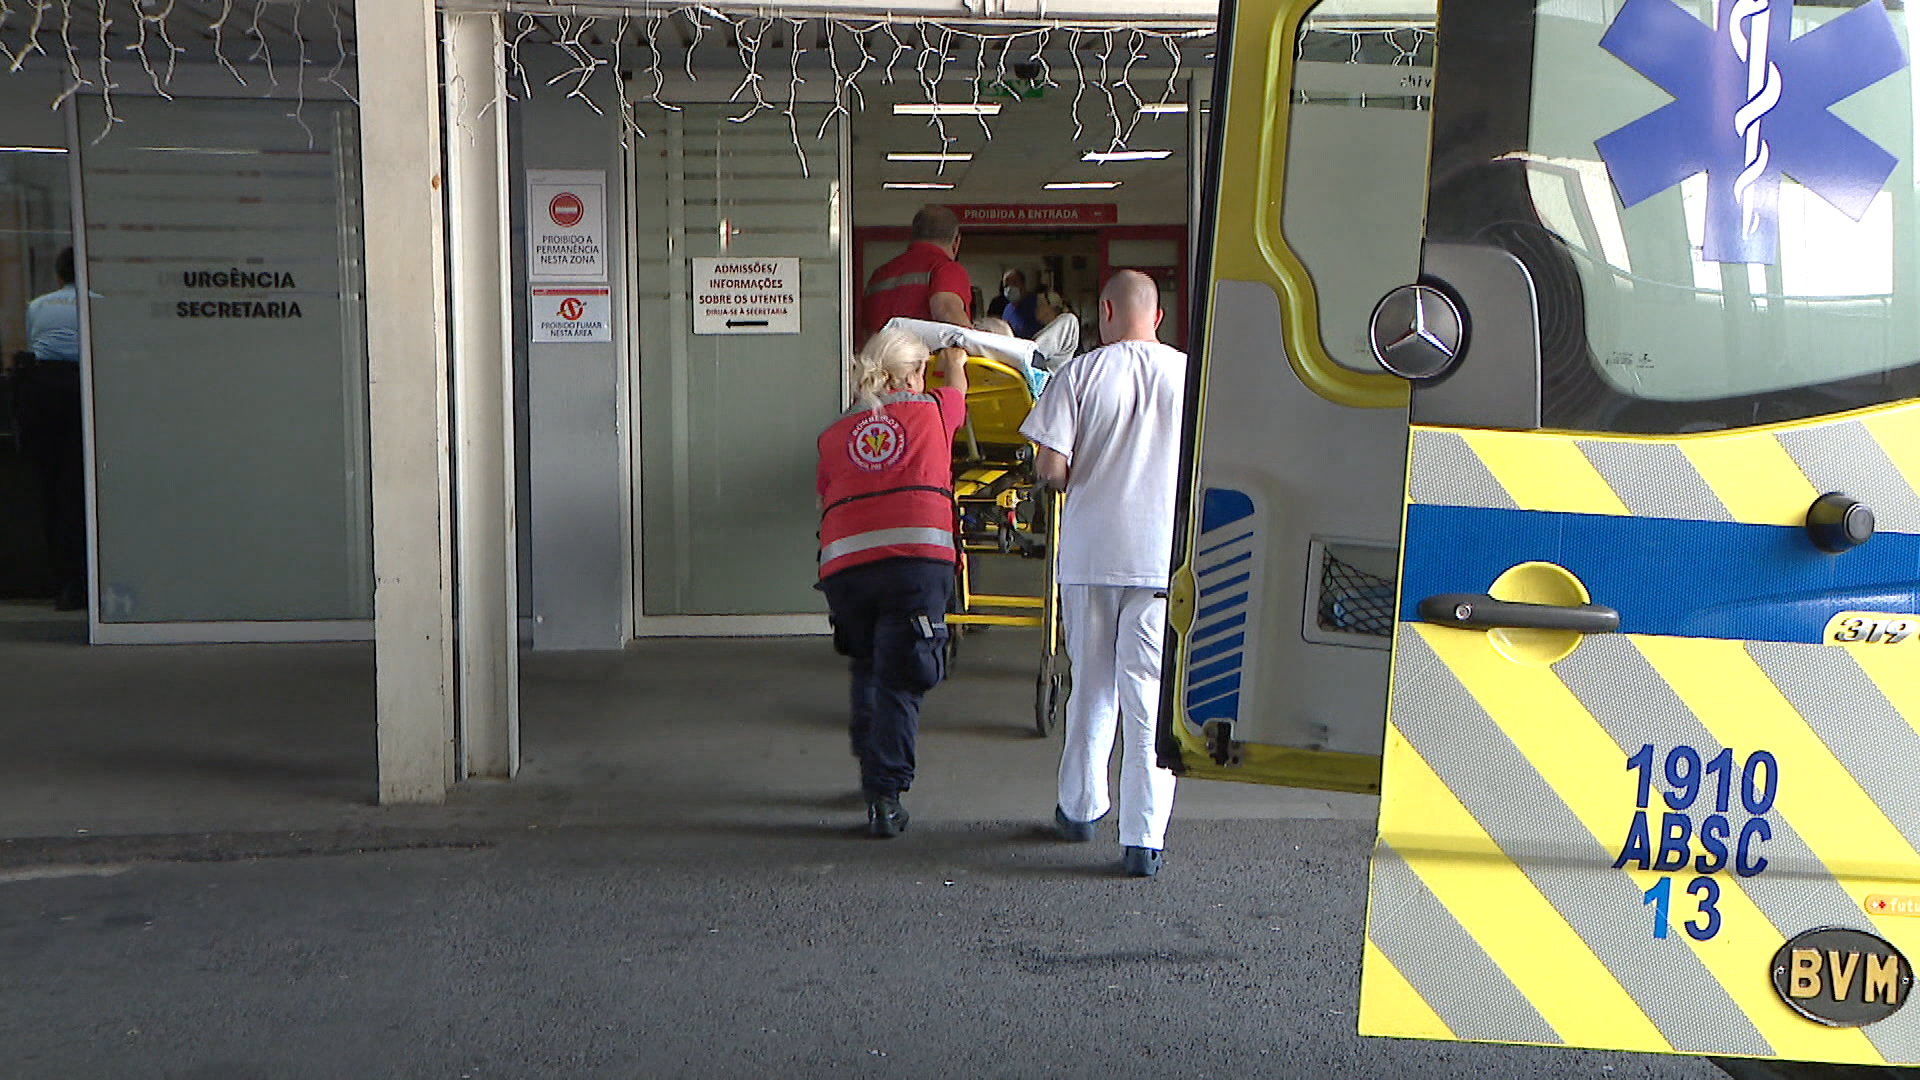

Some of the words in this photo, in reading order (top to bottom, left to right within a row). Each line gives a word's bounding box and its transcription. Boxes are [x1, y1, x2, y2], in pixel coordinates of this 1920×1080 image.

[964, 208, 1015, 220] PROIBIDA
[1018, 208, 1026, 219] A
[1028, 208, 1079, 219] ENTRADA
[542, 234, 585, 245] PROIBIDO
[586, 235, 593, 244] A
[536, 244, 600, 255] PERMANÊNCIA
[540, 255, 568, 265] NESTA
[570, 255, 596, 265] ZONA
[714, 261, 778, 275] ADMISSÕES/
[183, 267, 297, 289] URGÊNCIA
[709, 277, 783, 291] INFORMAÇÕES
[699, 294, 732, 305] SOBRE
[734, 294, 748, 305] OS
[749, 294, 794, 305] UTENTES
[176, 301, 303, 319] SECRETARIA
[705, 308, 738, 317] DIRIJA-SE
[746, 308, 788, 316] SECRETARIA
[541, 321, 575, 329] PROIBIDO
[576, 321, 603, 329] FUMAR
[550, 329, 573, 337] NESTA
[574, 328, 593, 337] ÁREA
[1834, 617, 1915, 645] 319
[1626, 743, 1778, 816] 1910
[1610, 810, 1772, 878] ABSC
[1643, 876, 1722, 942] 13
[1788, 946, 1899, 1005] BVM
